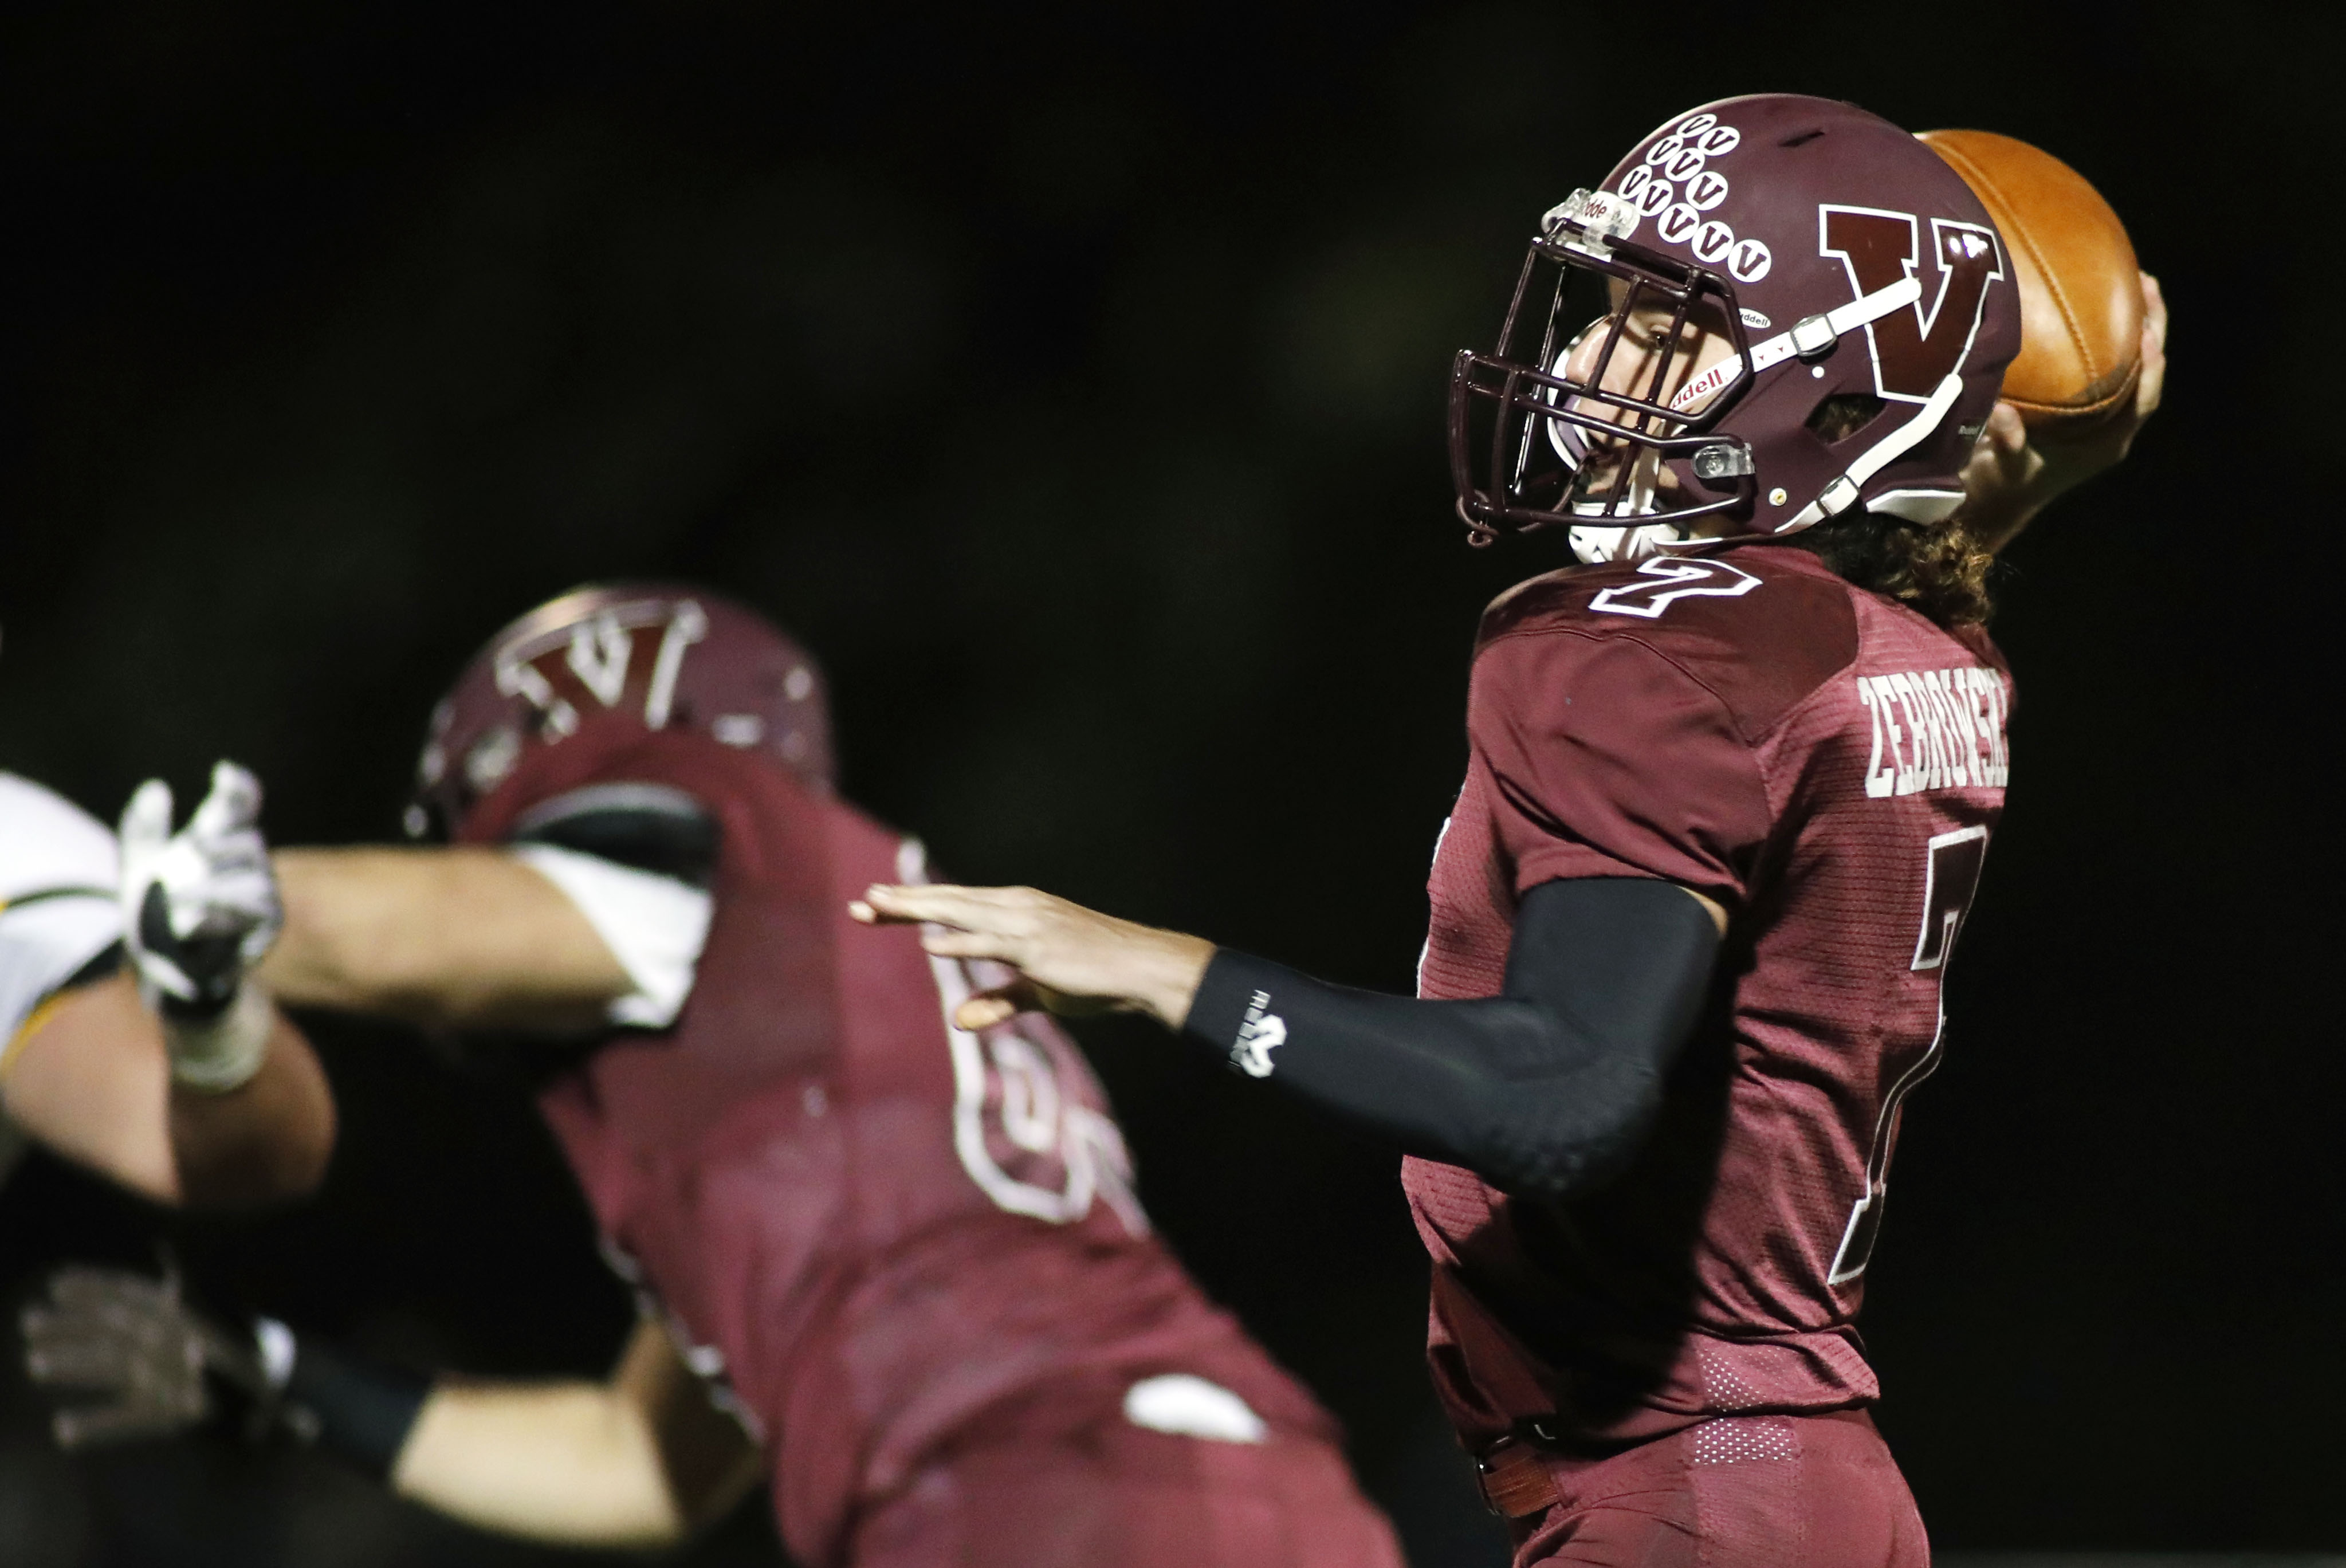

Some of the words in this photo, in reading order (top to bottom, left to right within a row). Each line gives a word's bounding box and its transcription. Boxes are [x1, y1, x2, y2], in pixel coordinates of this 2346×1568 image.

[1682, 117, 1712, 134] V
[1704, 129, 1736, 151] V
[1652, 140, 1679, 161] V
[1671, 151, 1700, 176] V
[1623, 171, 1648, 195] V
[1692, 175, 1724, 205] V
[1642, 184, 1669, 213] V
[1665, 207, 1696, 238] V
[1699, 225, 1731, 257] V
[1736, 243, 1767, 277] V
[1819, 204, 2004, 404] V
[1672, 368, 1724, 408] ddell
[1588, 556, 1763, 618] 7
